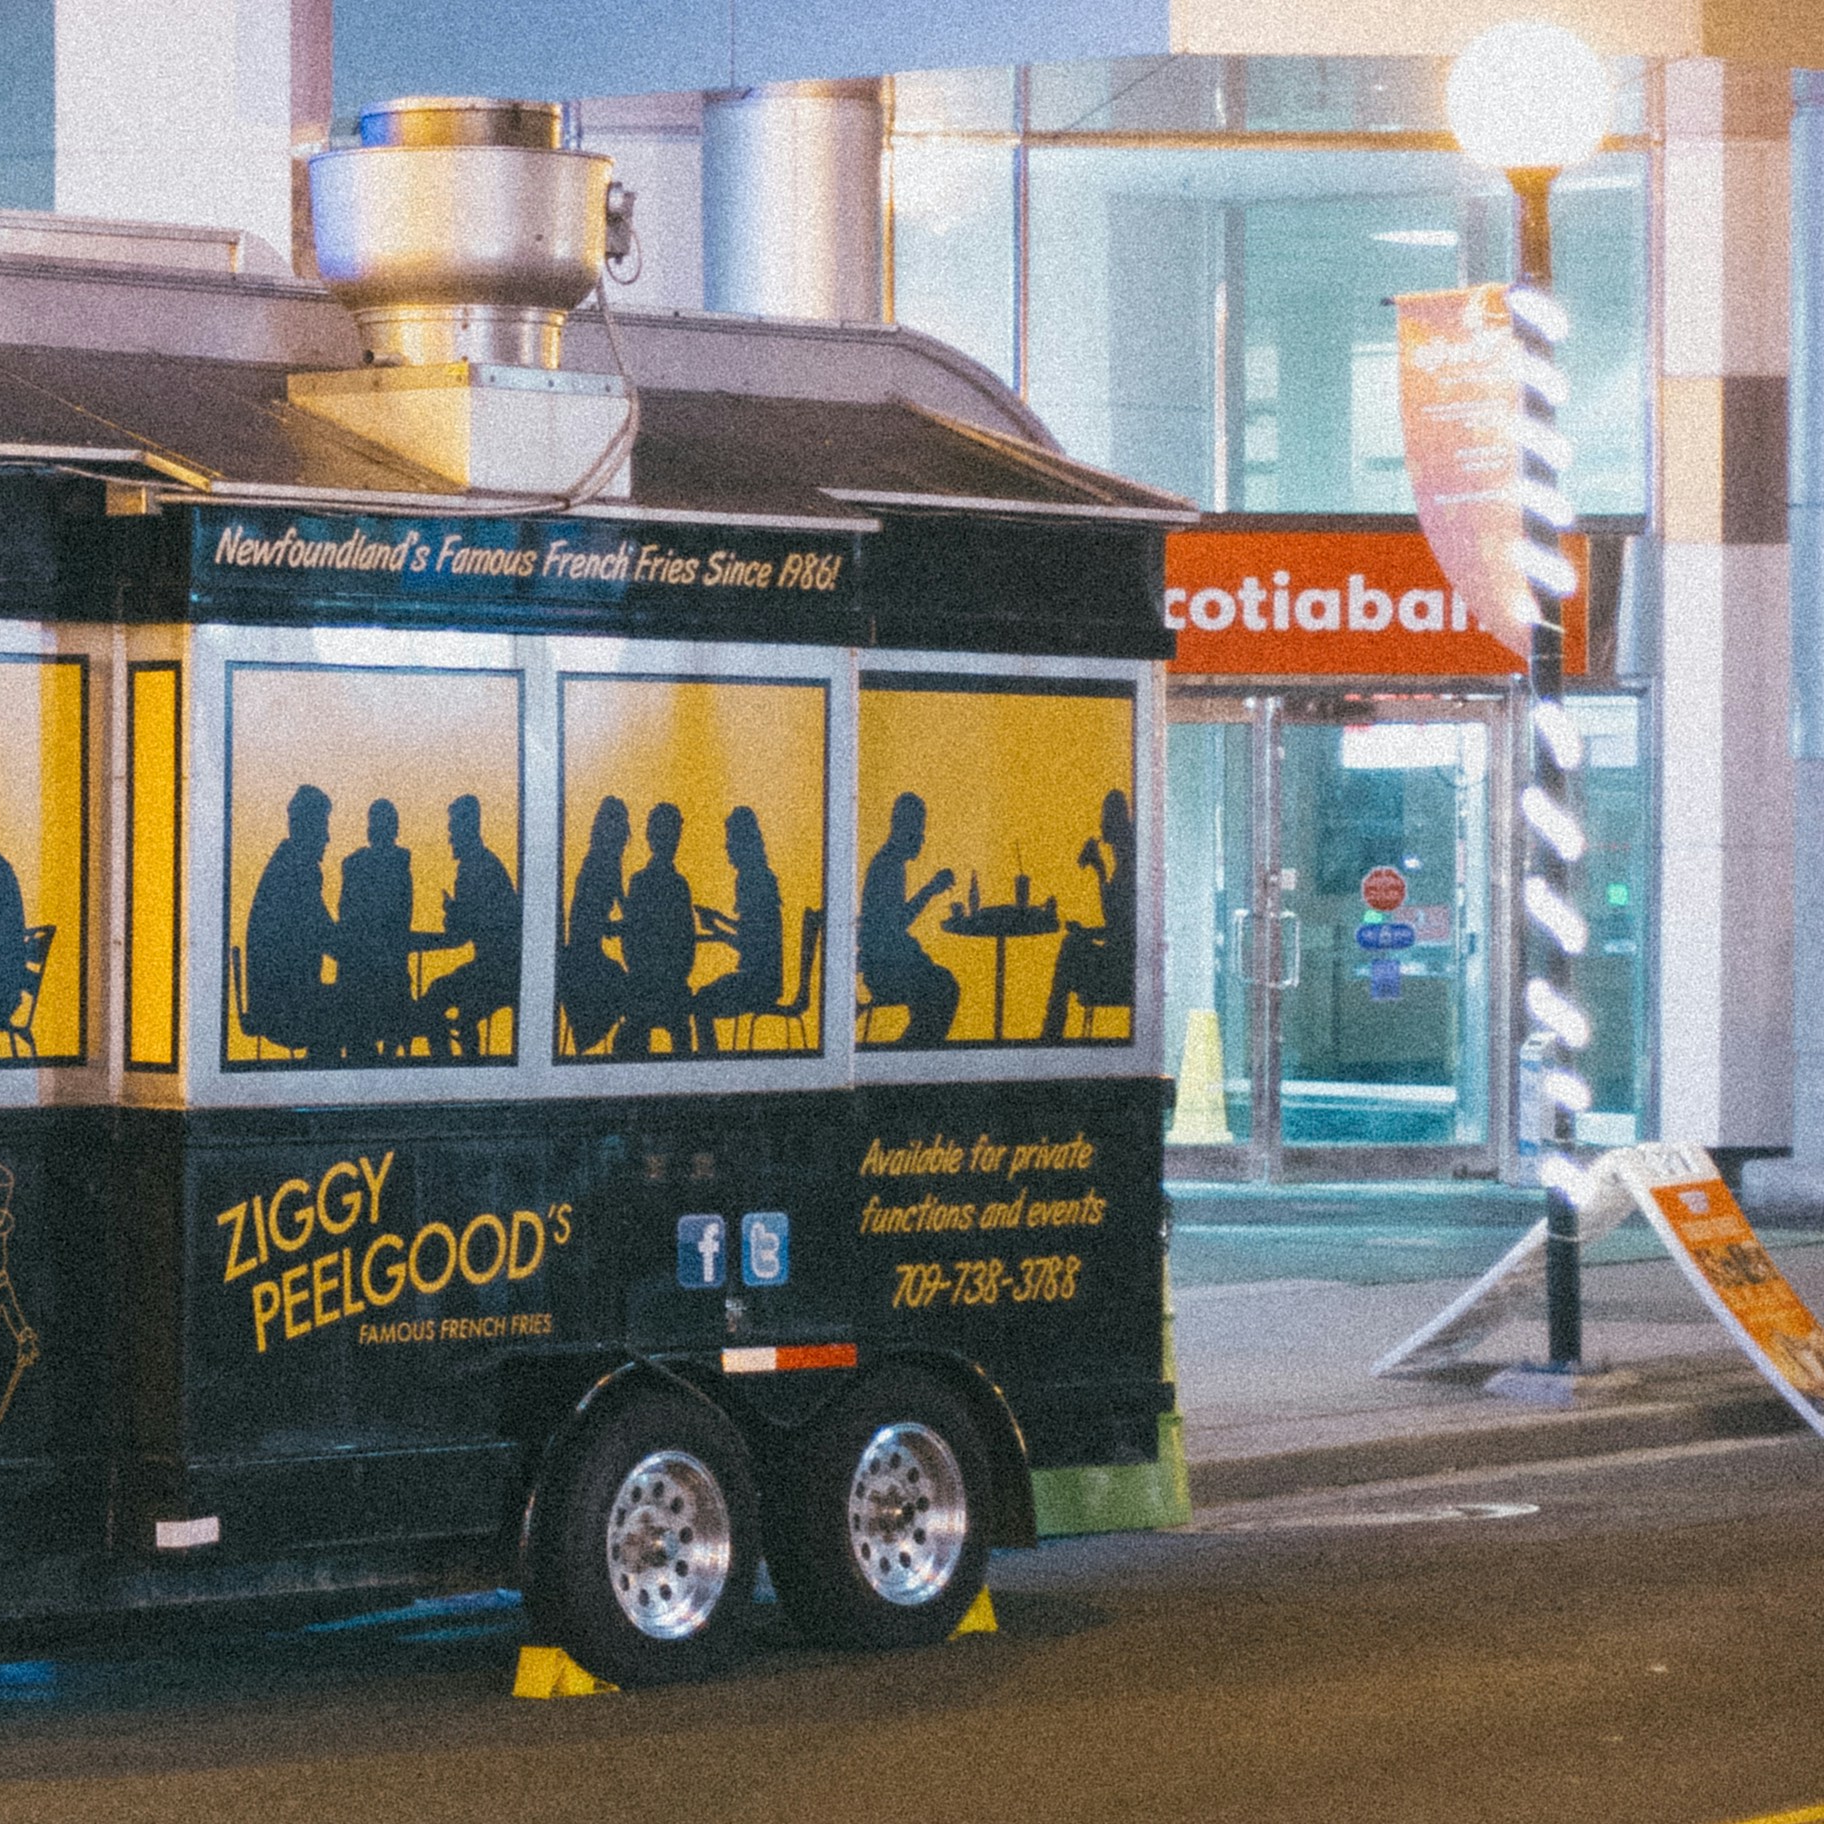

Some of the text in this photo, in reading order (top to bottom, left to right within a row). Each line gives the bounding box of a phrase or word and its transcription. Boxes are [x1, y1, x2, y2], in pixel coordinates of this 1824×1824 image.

[215, 525, 844, 592] Newfoundland's Famous French Fries Since 1986!
[860, 1130, 1095, 1181] Available for private
[217, 1150, 395, 1283] ZIGGY
[860, 1186, 1108, 1235] functions and events
[251, 1202, 573, 1353] PEELGOOD'S
[893, 1253, 1083, 1309] 709-738-3788
[358, 1312, 553, 1345] FAMOUS FRENCH FRIES
